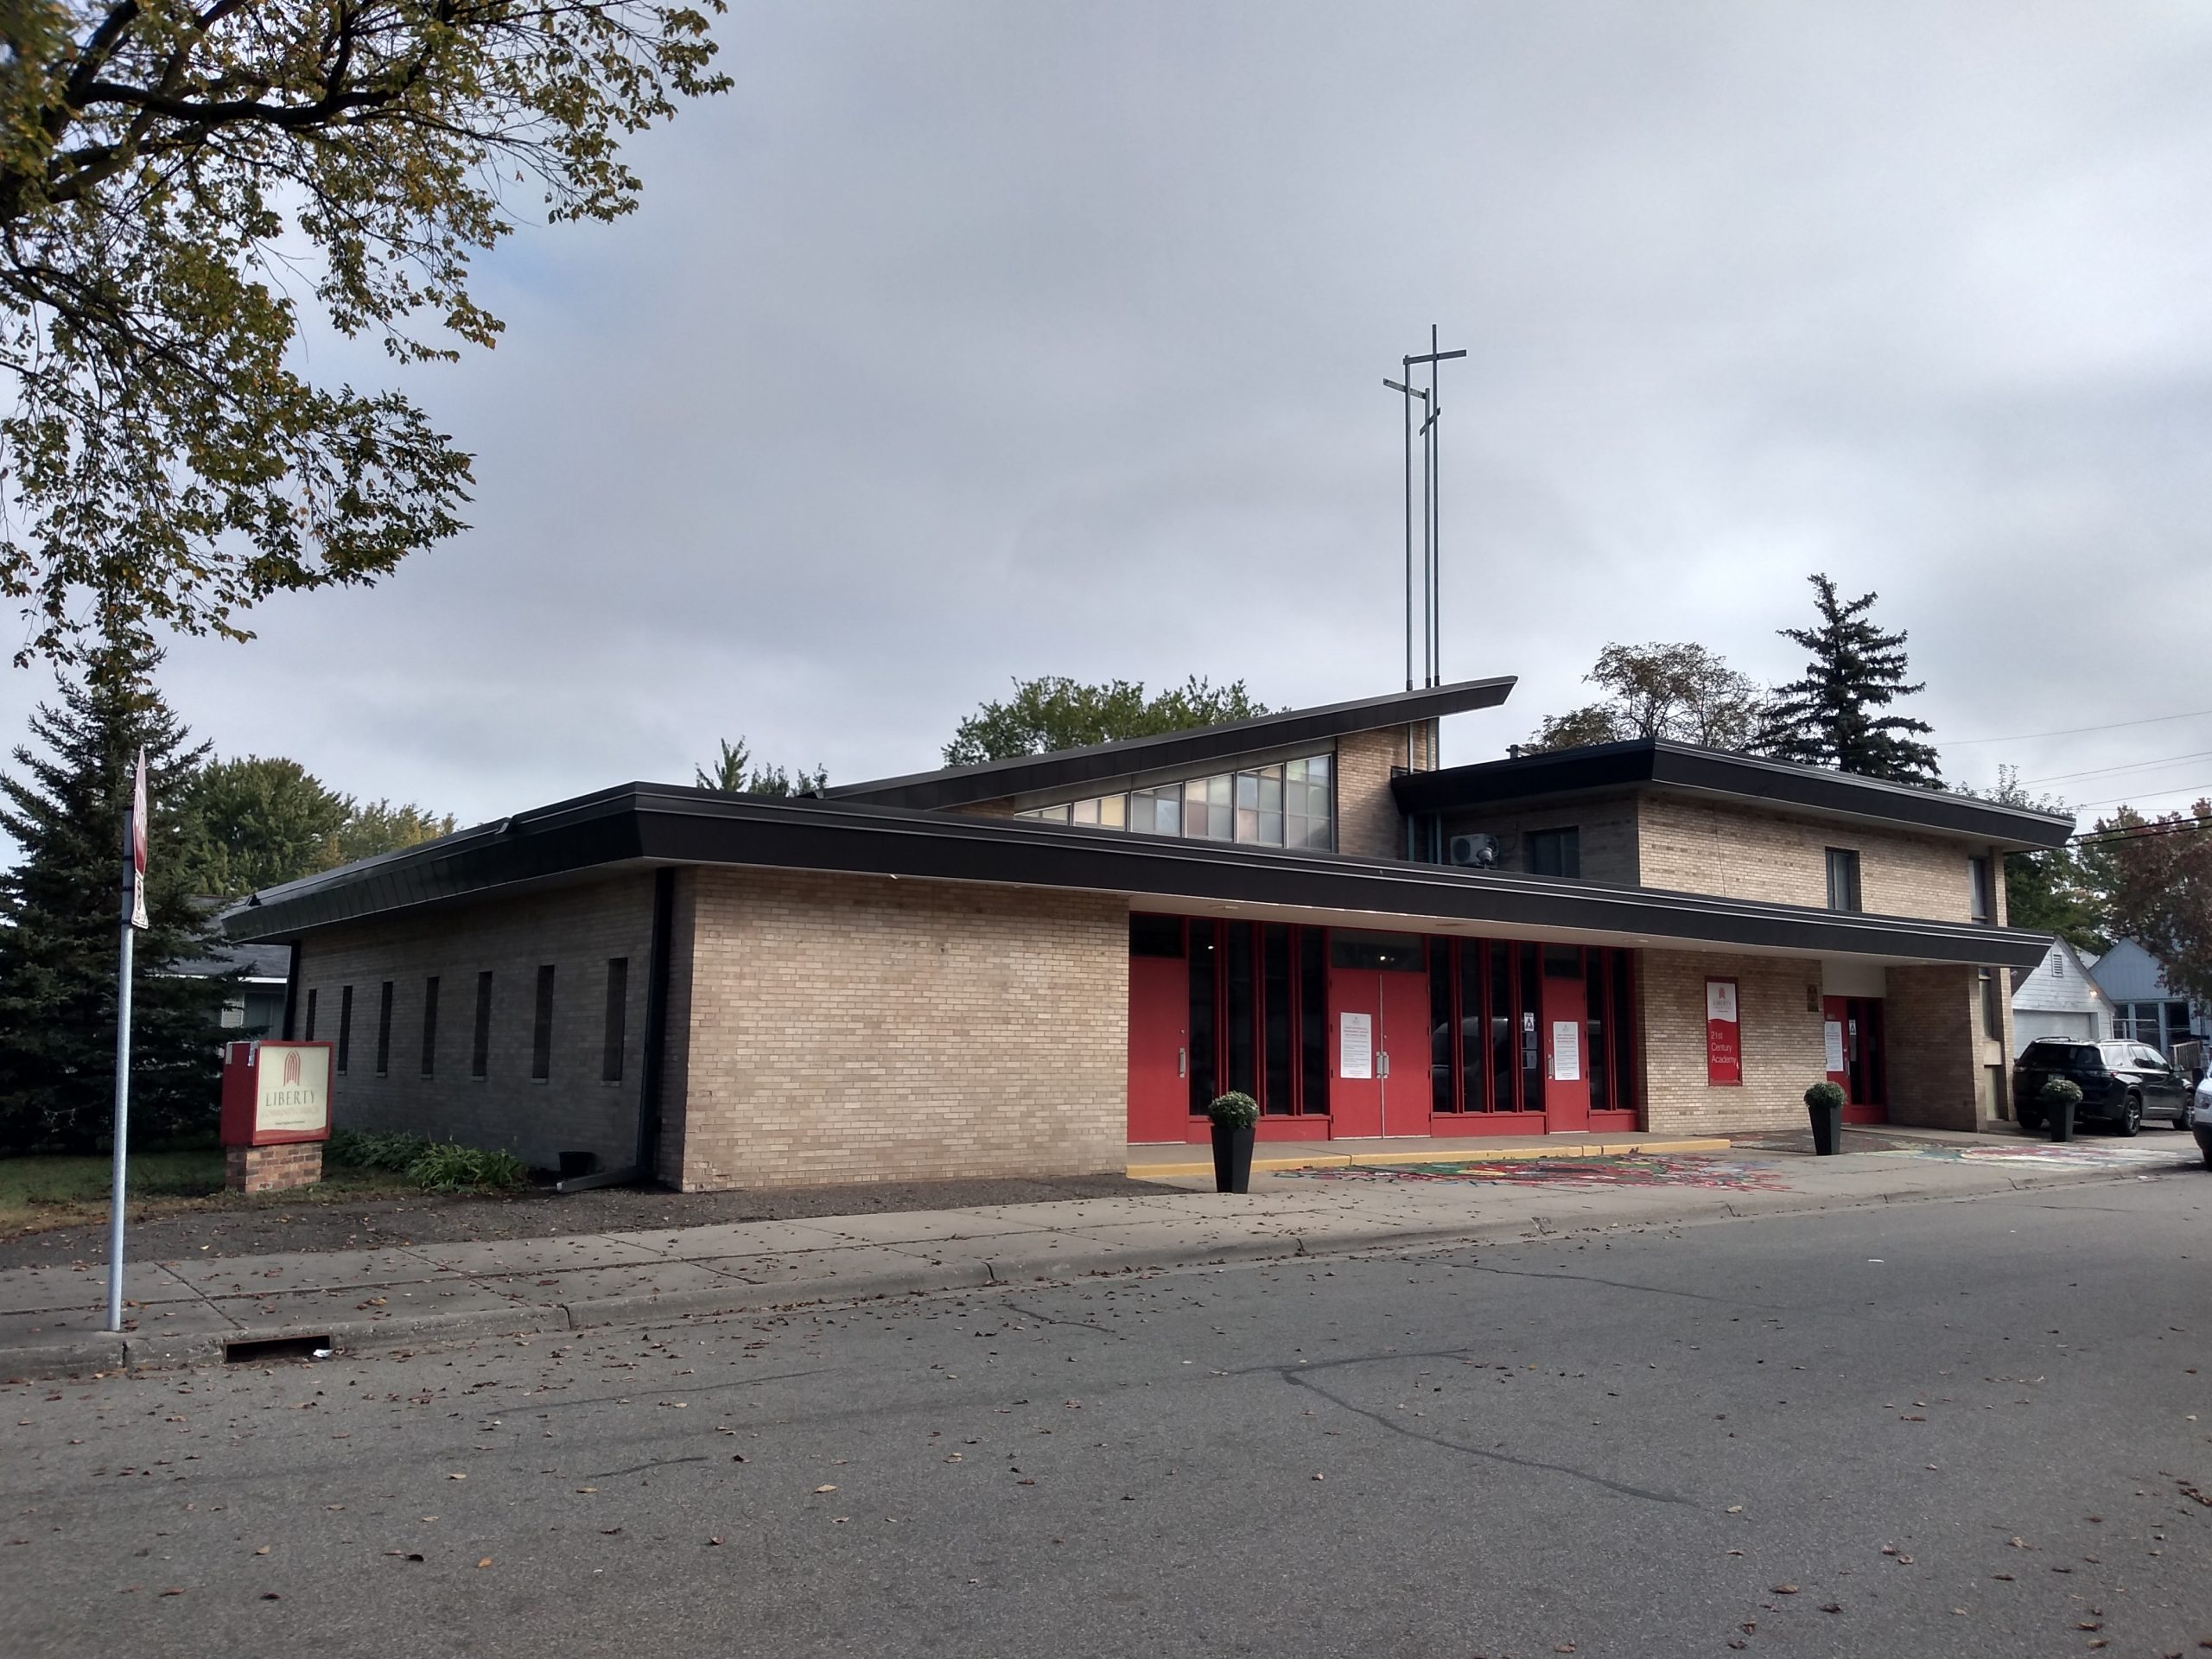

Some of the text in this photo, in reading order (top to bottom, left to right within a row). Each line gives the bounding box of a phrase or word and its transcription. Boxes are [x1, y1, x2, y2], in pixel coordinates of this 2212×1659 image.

[1711, 1031, 1723, 1039] 21st
[1711, 1042, 1732, 1053] Century
[1711, 1055, 1737, 1065] Academy
[266, 1090, 315, 1106] LIBERTY
